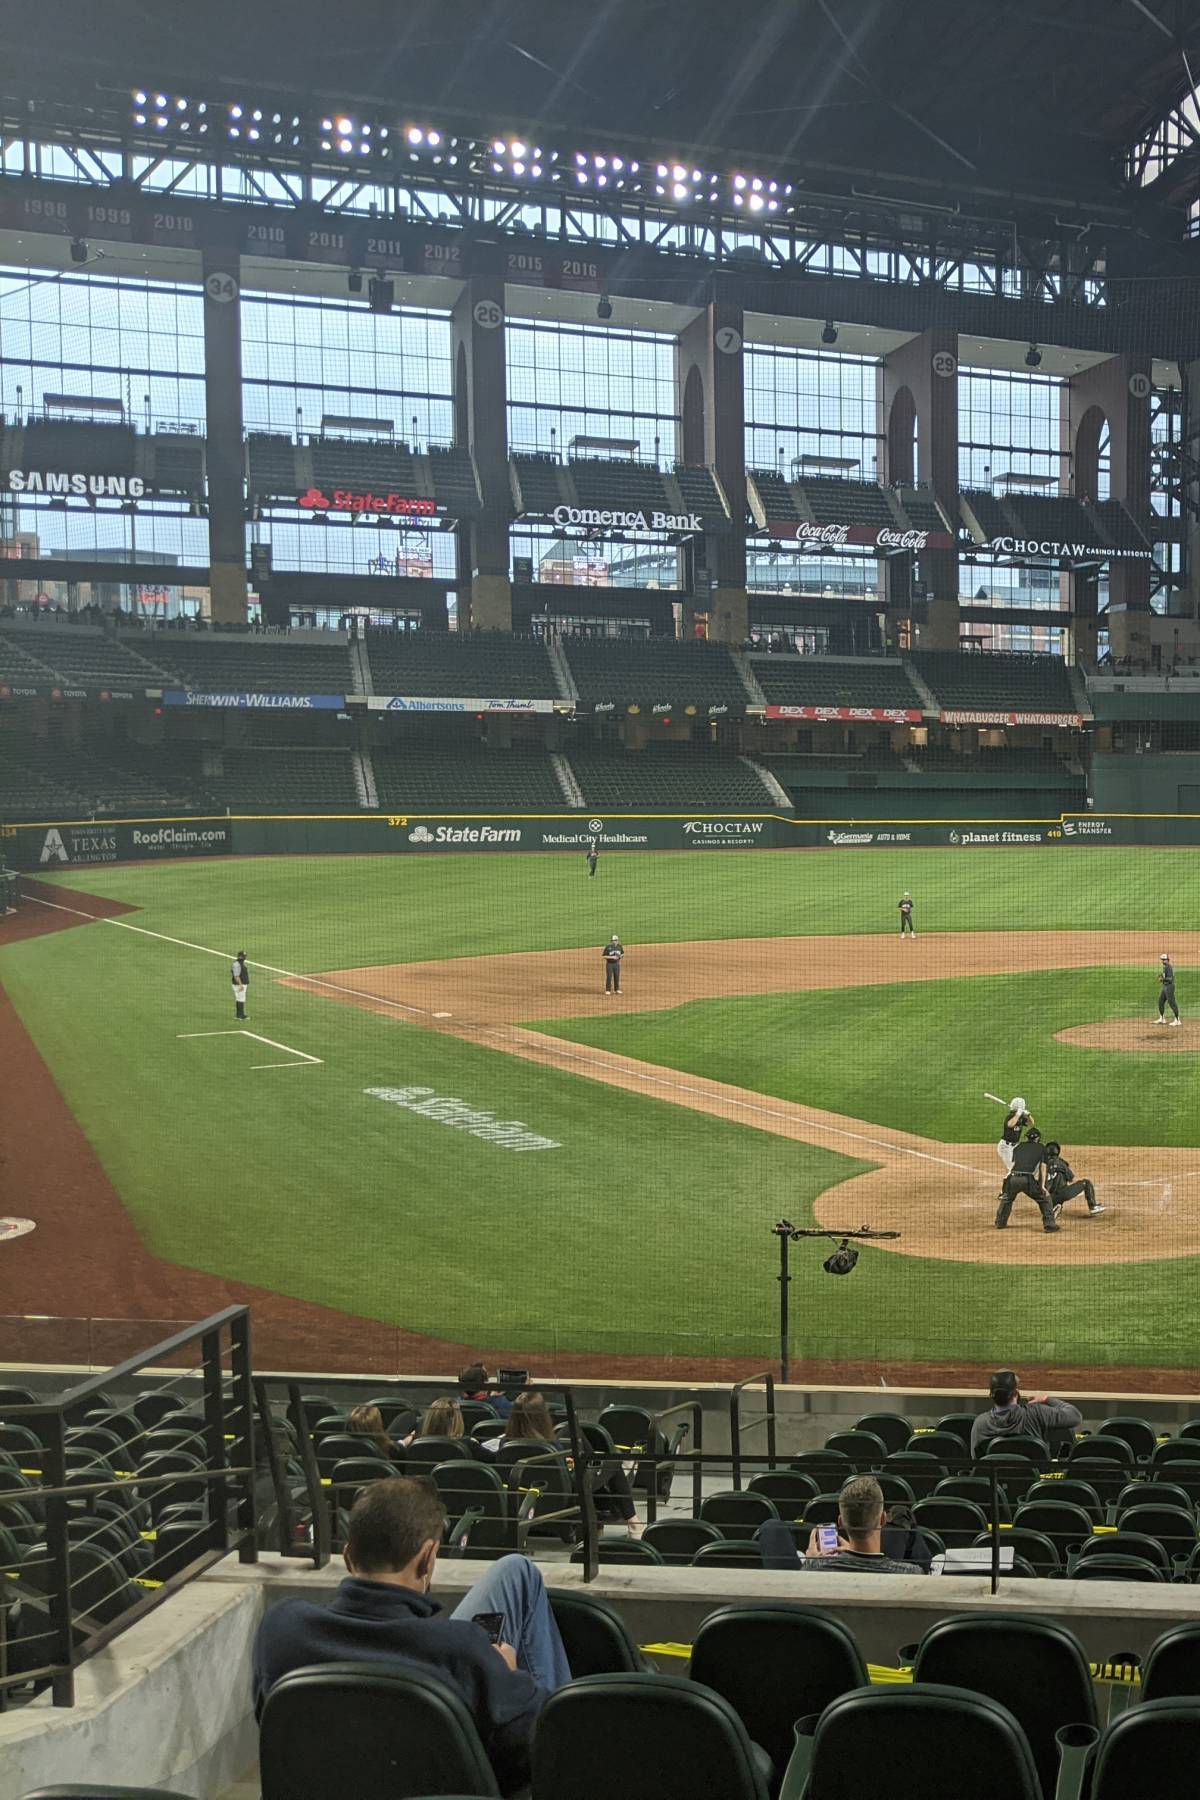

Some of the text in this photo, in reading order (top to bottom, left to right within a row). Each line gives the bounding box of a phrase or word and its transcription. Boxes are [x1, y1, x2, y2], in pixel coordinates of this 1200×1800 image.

[154, 213, 193, 231] 2010
[247, 225, 284, 242] 2010
[309, 231, 344, 249] 2011
[367, 238, 401, 255] 2011
[424, 244, 460, 262] 2012
[508, 254, 543, 271] 2015
[562, 260, 598, 278] 2016
[209, 278, 235, 297] 34
[477, 305, 499, 323] 26
[723, 333, 735, 349] 7
[936, 356, 953, 371] 29
[1133, 377, 1146, 393] 10
[9, 469, 145, 496] SAMSUNG
[651, 511, 702, 532] Bank
[796, 522, 850, 543] Coca-Cola
[876, 527, 929, 549] Coca-Cola
[1001, 536, 1085, 557] CHOCTAW
[1122, 550, 1152, 558] RESORTS
[407, 700, 465, 711] Albertsons
[779, 706, 805, 714] DEX
[814, 707, 839, 715] DEX
[849, 708, 874, 716] DEX
[944, 711, 1078, 725] WHATABURGER WHATABURGER
[388, 818, 407, 826] 372
[692, 821, 764, 833] CHOCTAW
[133, 828, 226, 844] RoofClaim.com
[542, 834, 648, 845] Medical City Healthcare
[962, 831, 1042, 845] planet fitness
[1047, 830, 1061, 838] 410
[71, 837, 117, 851] TEXAS
[72, 852, 117, 863] ARLINGTON
